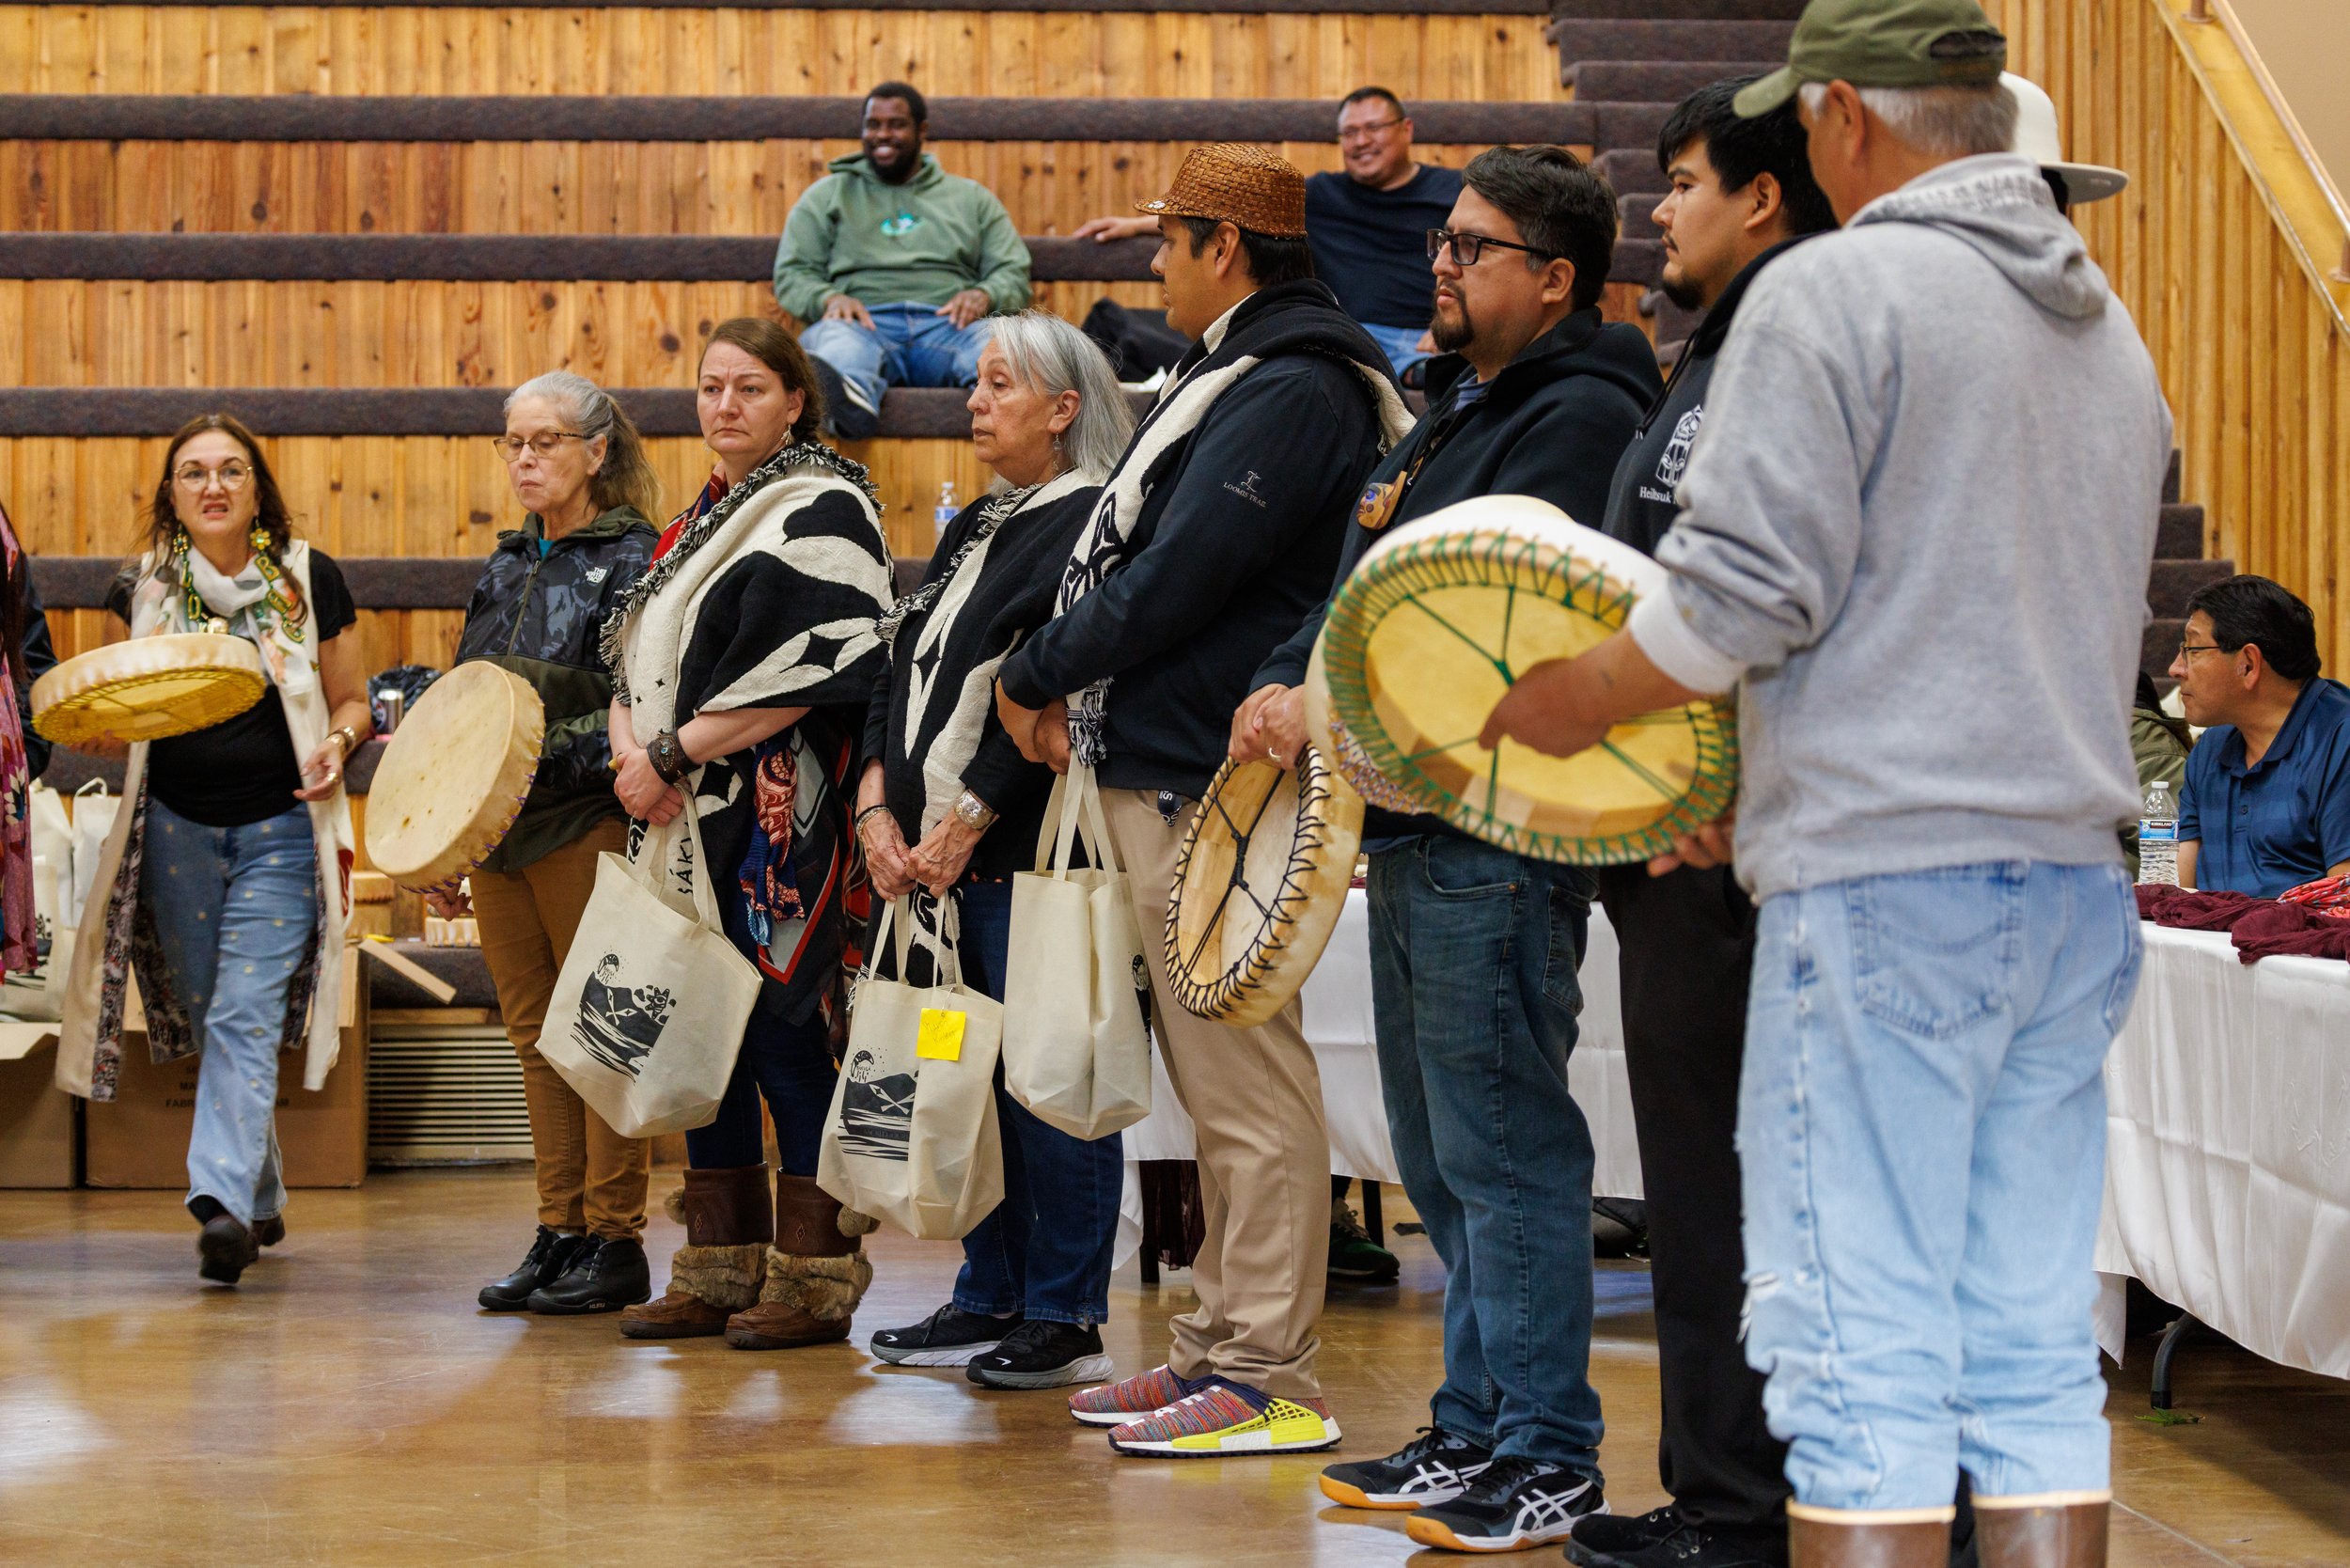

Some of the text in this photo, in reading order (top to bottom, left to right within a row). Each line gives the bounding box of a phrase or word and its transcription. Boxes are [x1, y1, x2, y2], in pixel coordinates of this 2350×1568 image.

[1223, 481, 1267, 508] LOOMIS TRAIL
[1639, 485, 1672, 504] Heiltsuk
